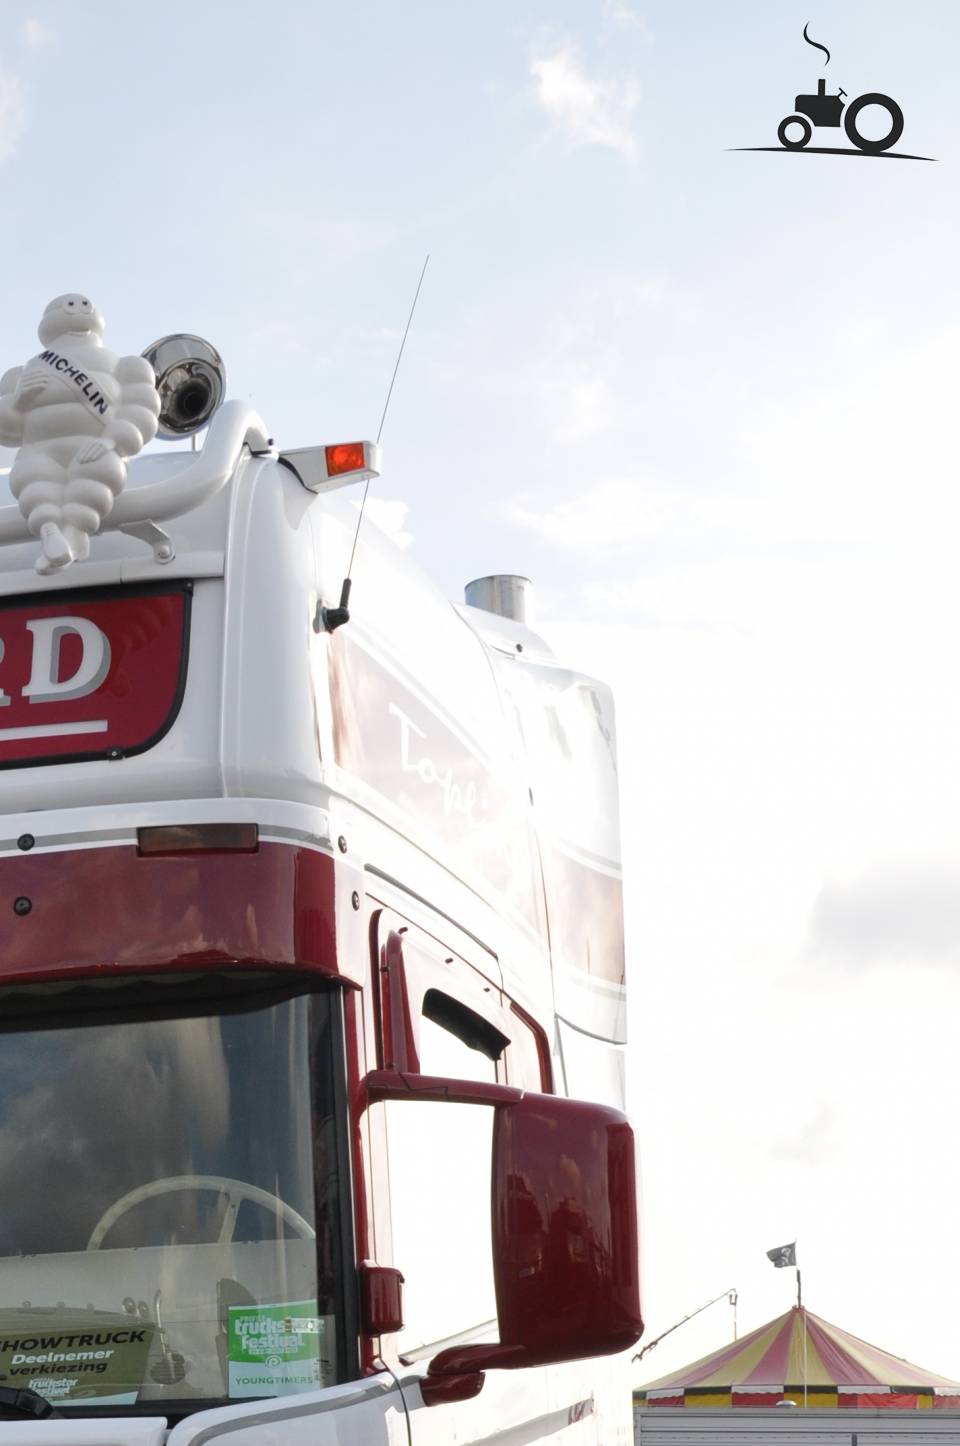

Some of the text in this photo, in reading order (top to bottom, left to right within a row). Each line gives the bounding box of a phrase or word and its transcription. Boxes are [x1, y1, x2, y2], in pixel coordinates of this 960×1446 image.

[39, 351, 108, 415] MICHELIN
[11, 1349, 114, 1365] Deelnemer
[9, 1362, 107, 1376] verkiezing
[235, 1376, 314, 1385] YOUNGTIMERS
